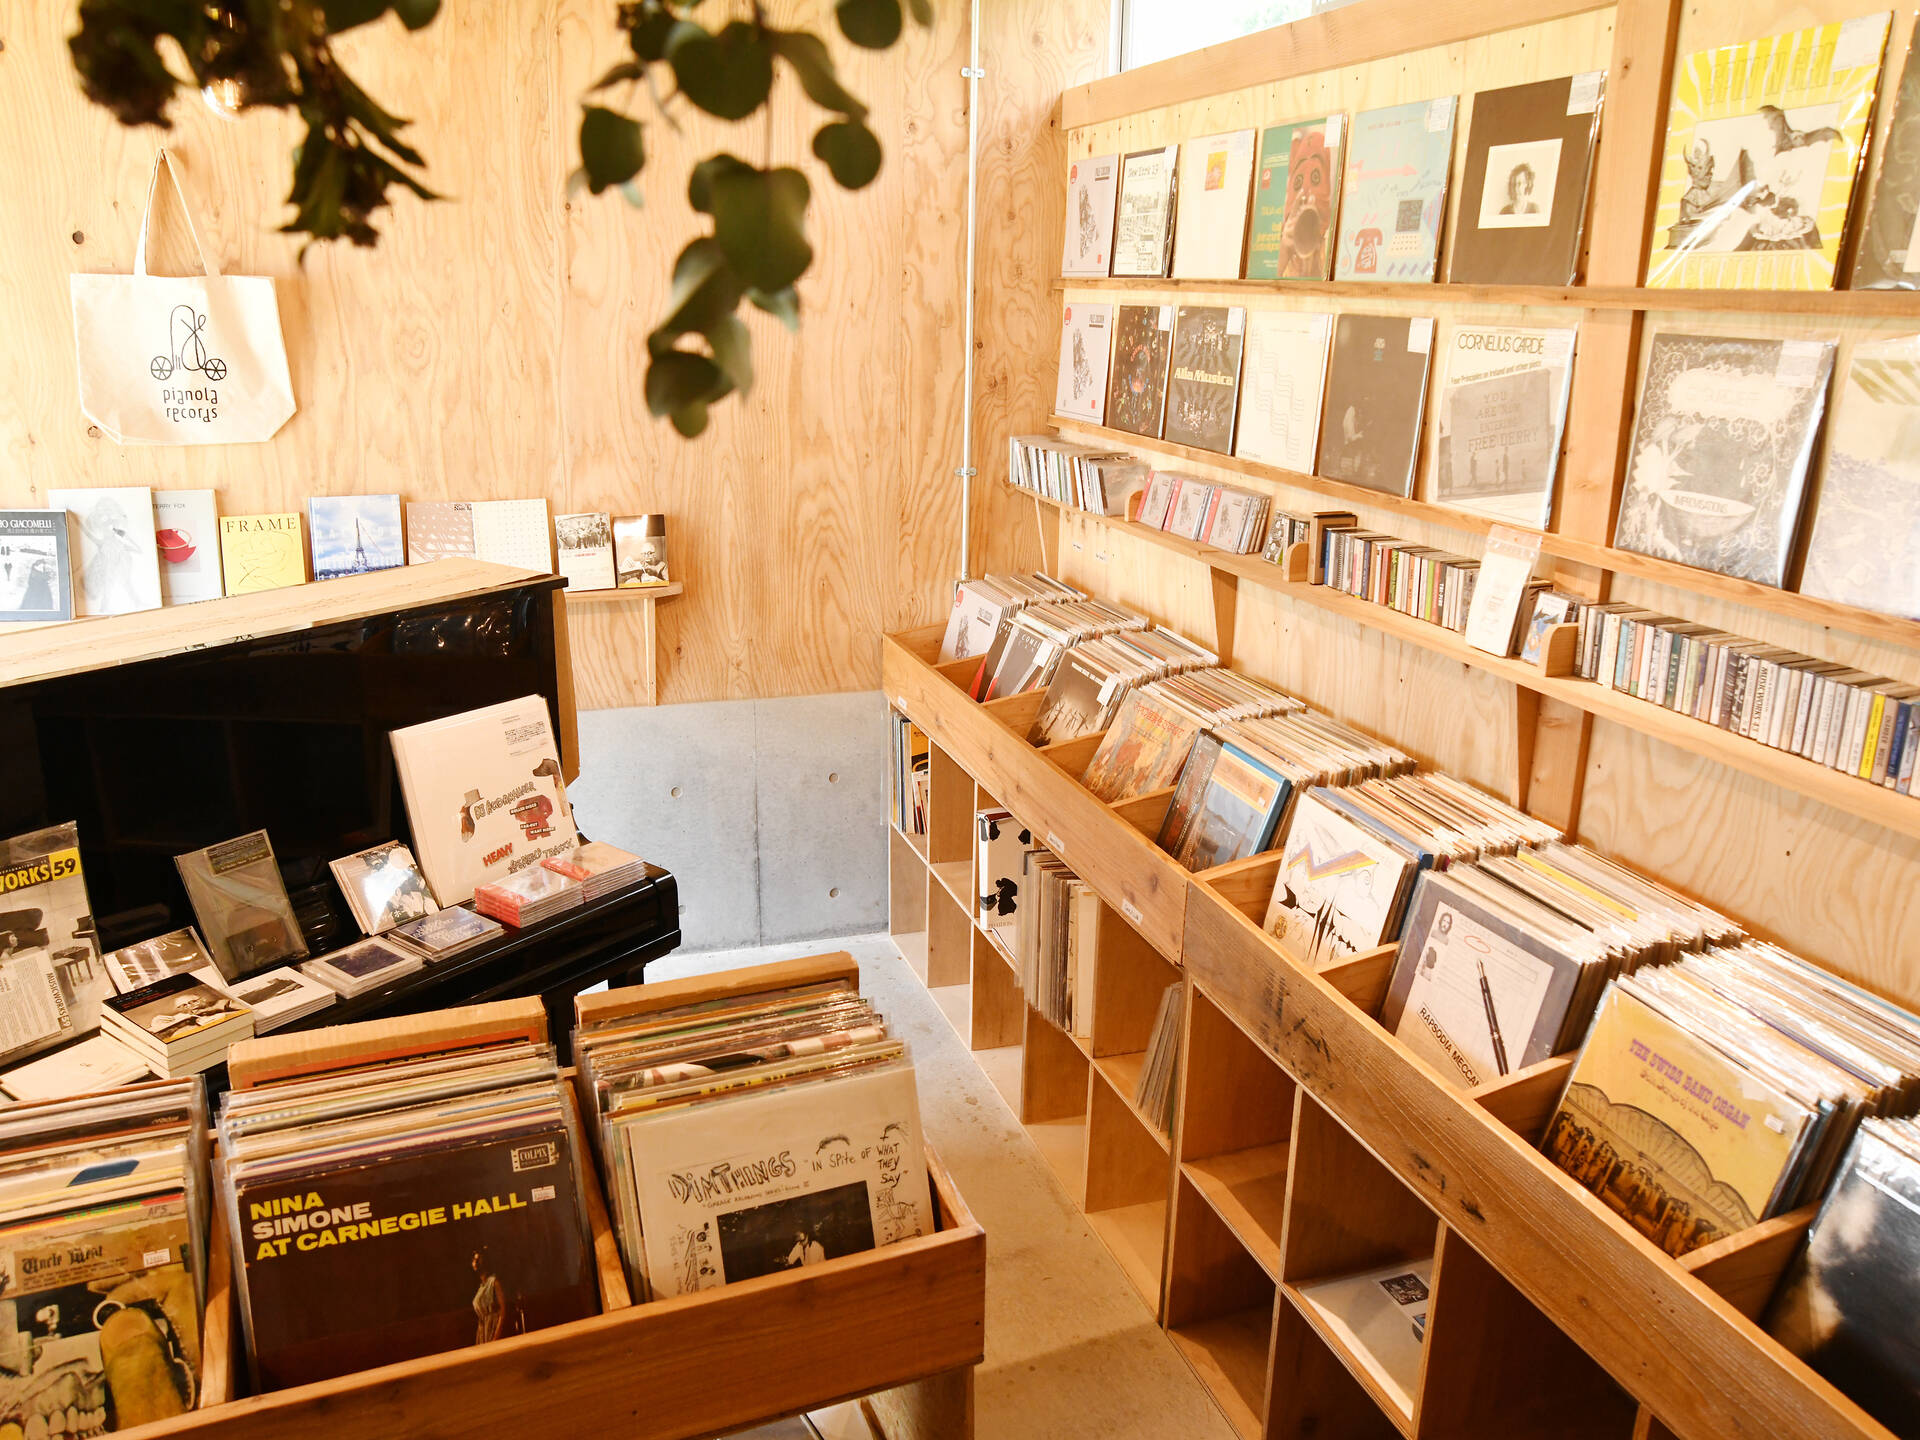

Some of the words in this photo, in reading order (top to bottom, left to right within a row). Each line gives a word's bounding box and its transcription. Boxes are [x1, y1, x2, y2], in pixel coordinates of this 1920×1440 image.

[1458, 333, 1511, 352] CORNELIUS
[1193, 369, 1234, 386] Musica
[163, 387, 218, 404] pianola
[166, 407, 218, 422] records
[1468, 436, 1496, 452] FREE
[10, 519, 52, 528] GIACOMELLI
[226, 518, 297, 533] FRAME
[483, 842, 512, 868] HEAVY
[54, 858, 77, 877] 59
[47, 972, 67, 1016] MUSICWORKS
[1419, 1007, 1453, 1053] RAPSODIA
[1630, 1039, 1651, 1061] THE
[1649, 1051, 1684, 1086] SWISS
[1684, 1077, 1717, 1106] BAND
[1712, 1096, 1752, 1130] ORGAN
[520, 1147, 548, 1161] COLPIX
[861, 1146, 871, 1159] OF
[876, 1143, 899, 1156] WHAT
[877, 1156, 900, 1172] THEY
[250, 1191, 324, 1220] NINA
[252, 1202, 372, 1240] SIMONE
[256, 1238, 292, 1260] AT
[296, 1207, 447, 1252] CARNEGIE
[452, 1192, 527, 1221] HALL
[22, 1253, 63, 1274] Uncle
[67, 1245, 103, 1265] Meat
